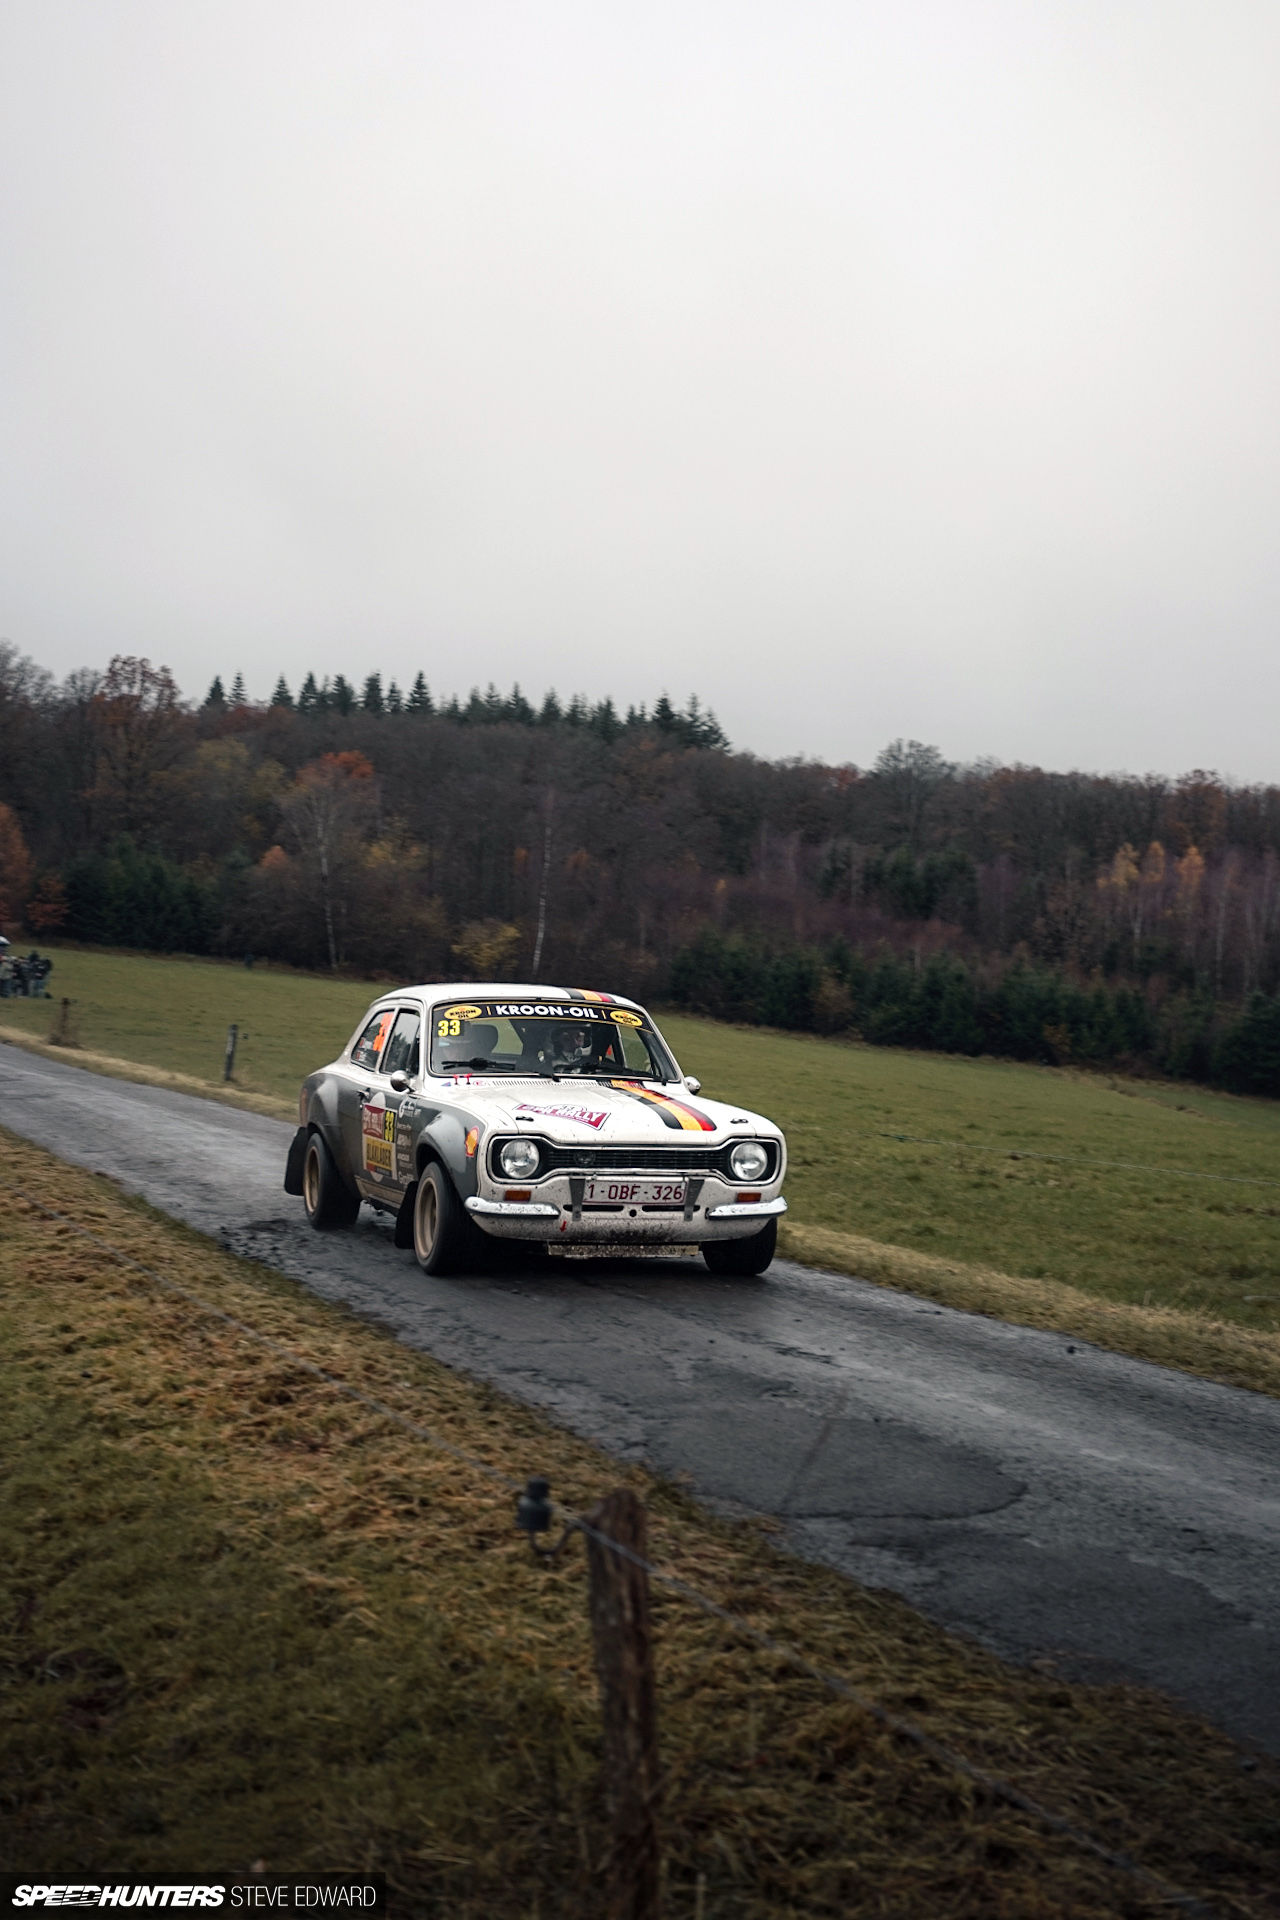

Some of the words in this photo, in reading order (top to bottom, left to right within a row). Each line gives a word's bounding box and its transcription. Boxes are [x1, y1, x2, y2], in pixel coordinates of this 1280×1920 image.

[495, 1004, 599, 1019] KROON-OIL
[438, 1020, 460, 1037] 33
[385, 1111, 395, 1143] 33
